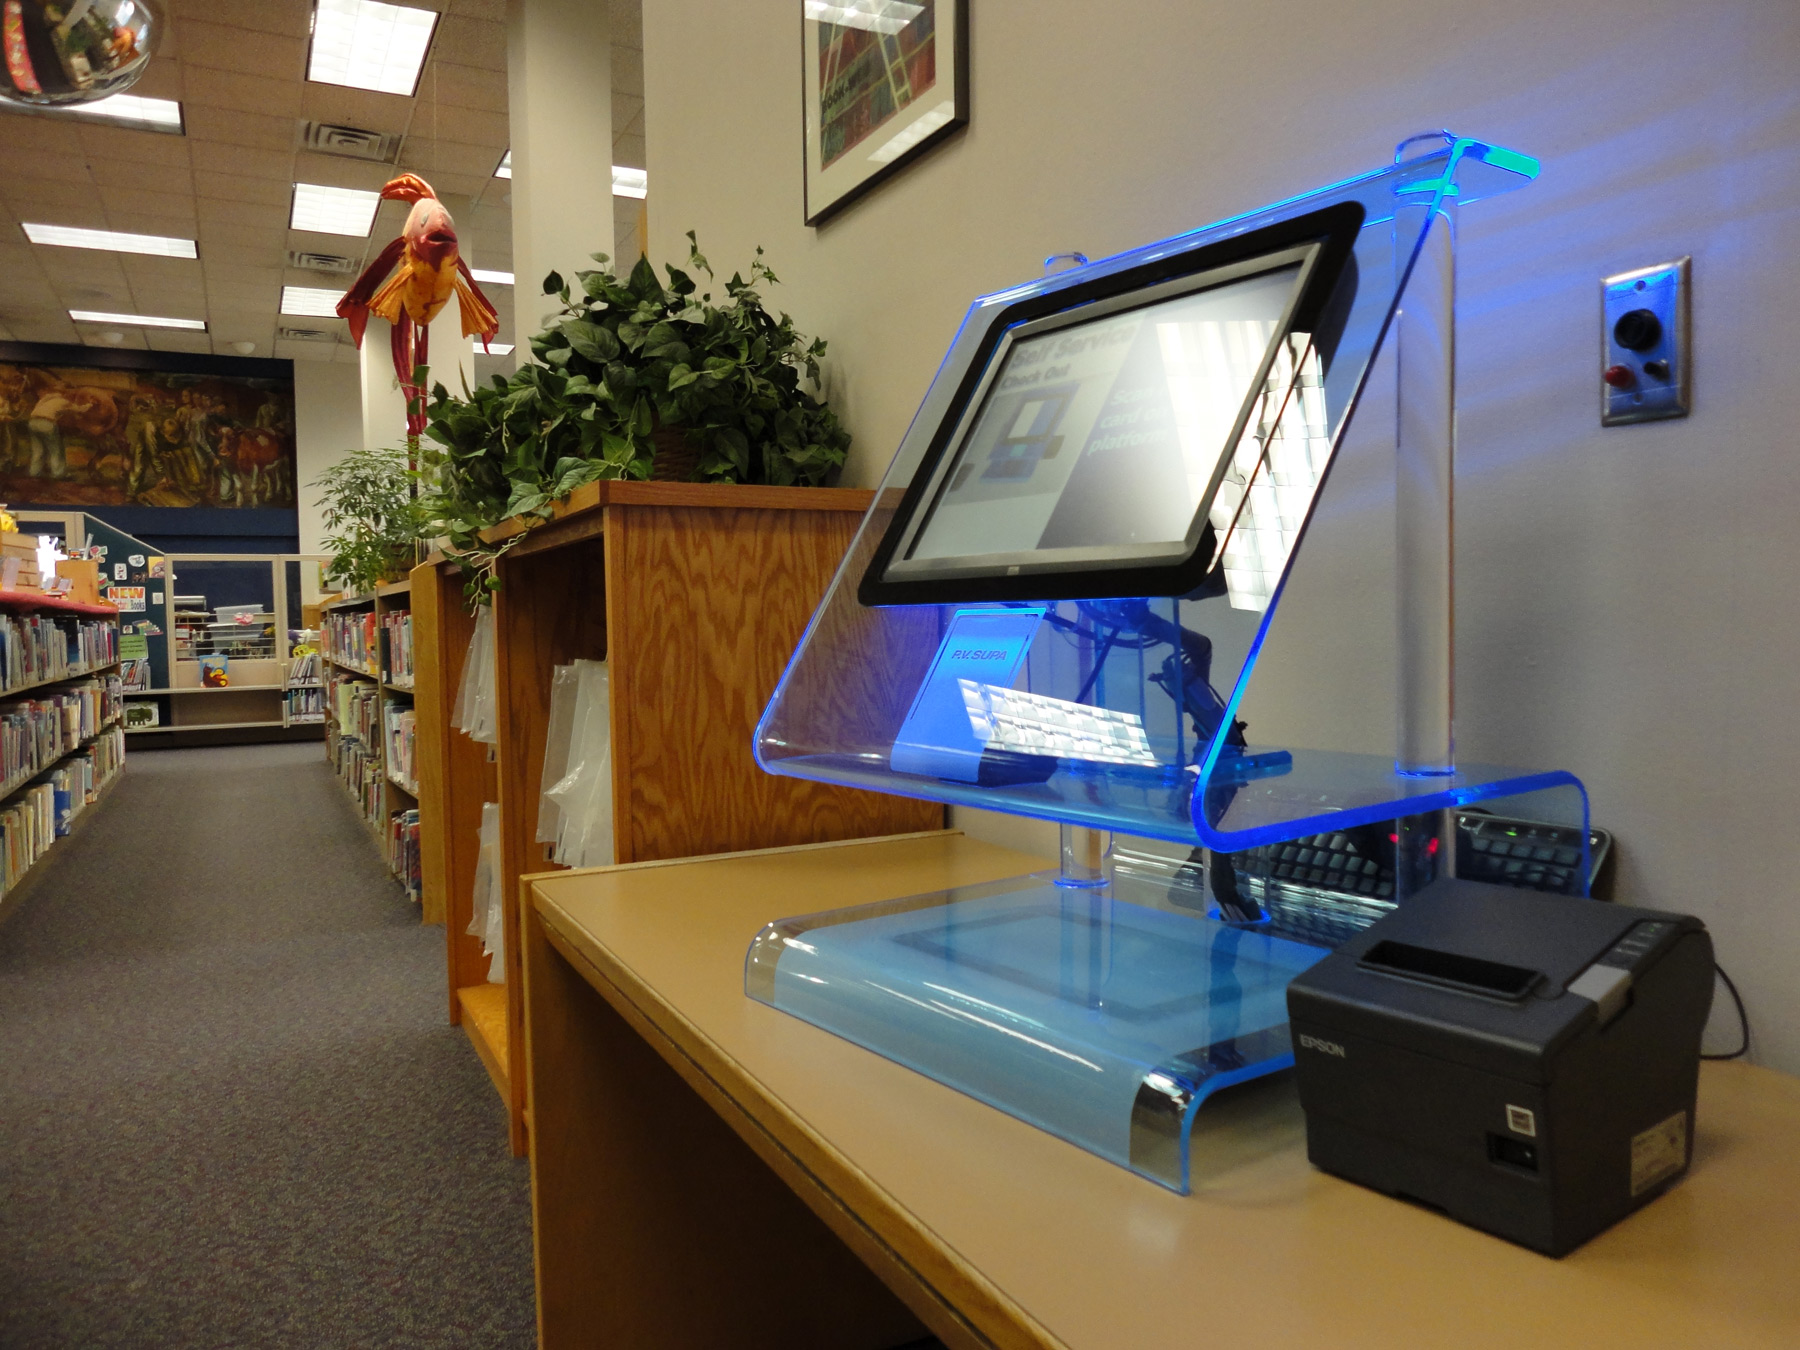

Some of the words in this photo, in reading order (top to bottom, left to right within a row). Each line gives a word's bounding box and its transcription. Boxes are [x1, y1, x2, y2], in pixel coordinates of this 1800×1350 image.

[1010, 341, 1056, 370] Self
[1055, 326, 1136, 358] Service
[1001, 370, 1041, 389] Check
[1044, 363, 1071, 381] Out
[1101, 407, 1141, 429] card
[109, 588, 144, 598] NEW
[1300, 1034, 1345, 1057] EPSON
